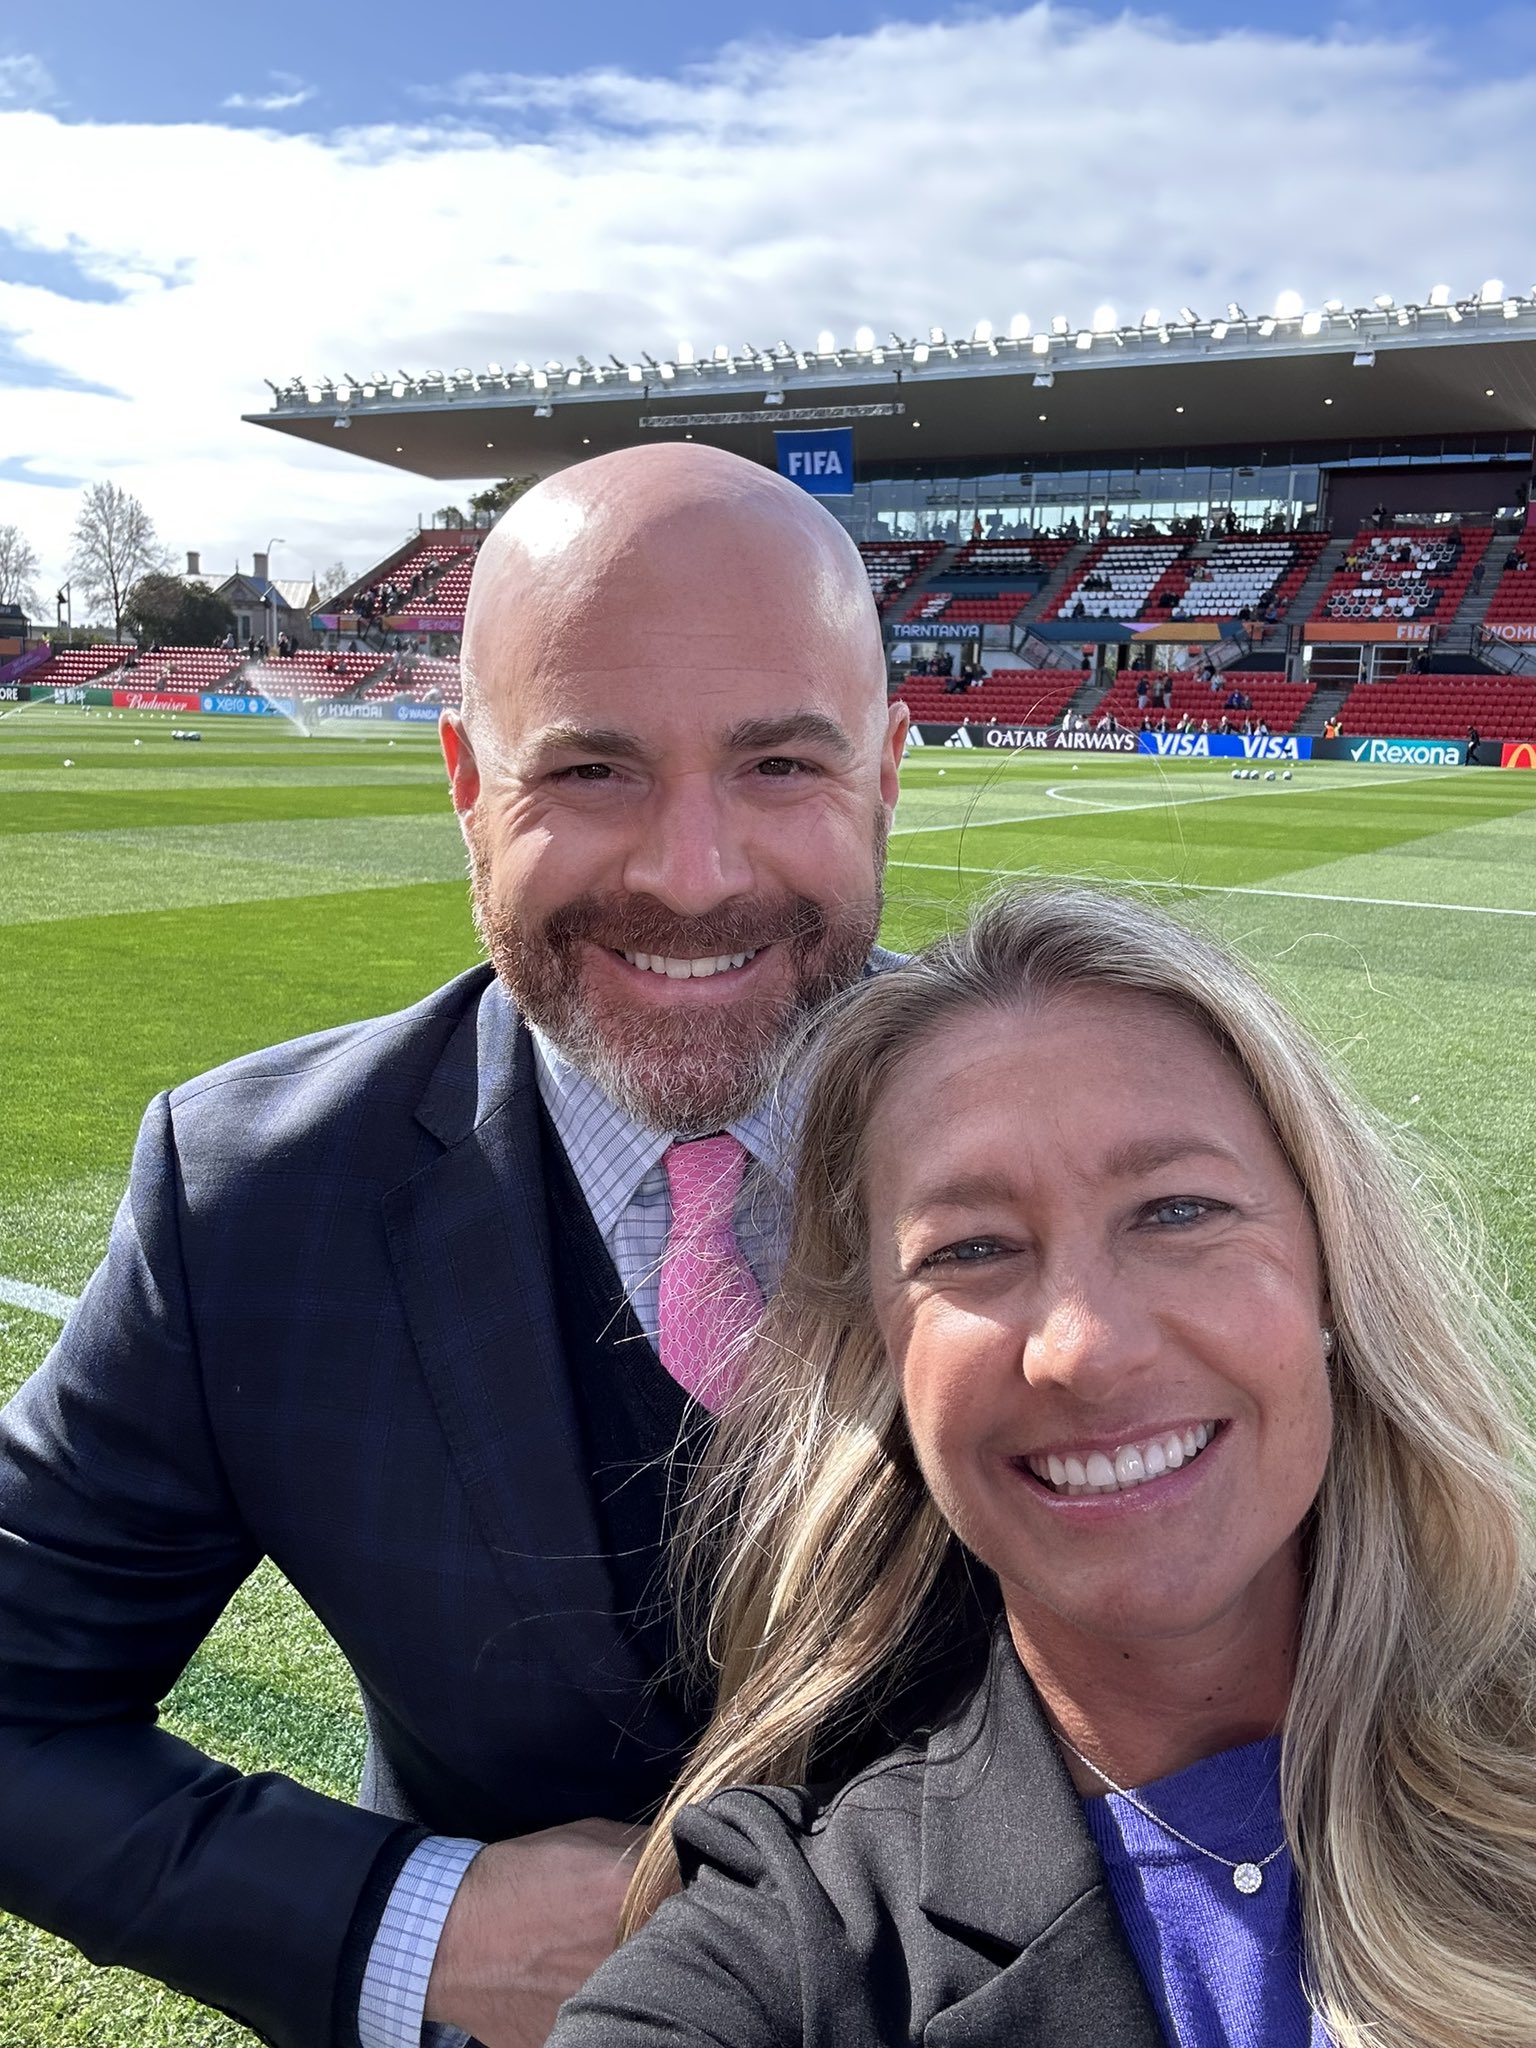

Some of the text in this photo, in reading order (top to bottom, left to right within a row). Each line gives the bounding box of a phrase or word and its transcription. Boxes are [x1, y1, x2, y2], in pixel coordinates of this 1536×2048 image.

[788, 450, 843, 476] FIFA
[418, 619, 461, 630] BEYOND
[893, 624, 980, 638] TARNTANYA
[126, 693, 188, 712] Budweiser
[216, 697, 246, 713] xero
[329, 704, 383, 718] HYUNDAI
[409, 709, 438, 720] WANDA
[986, 729, 1135, 752] QATAR AIRWAYS
[1153, 734, 1210, 757] VISA
[1238, 736, 1300, 759] VISA
[1369, 739, 1460, 765] Rexona
